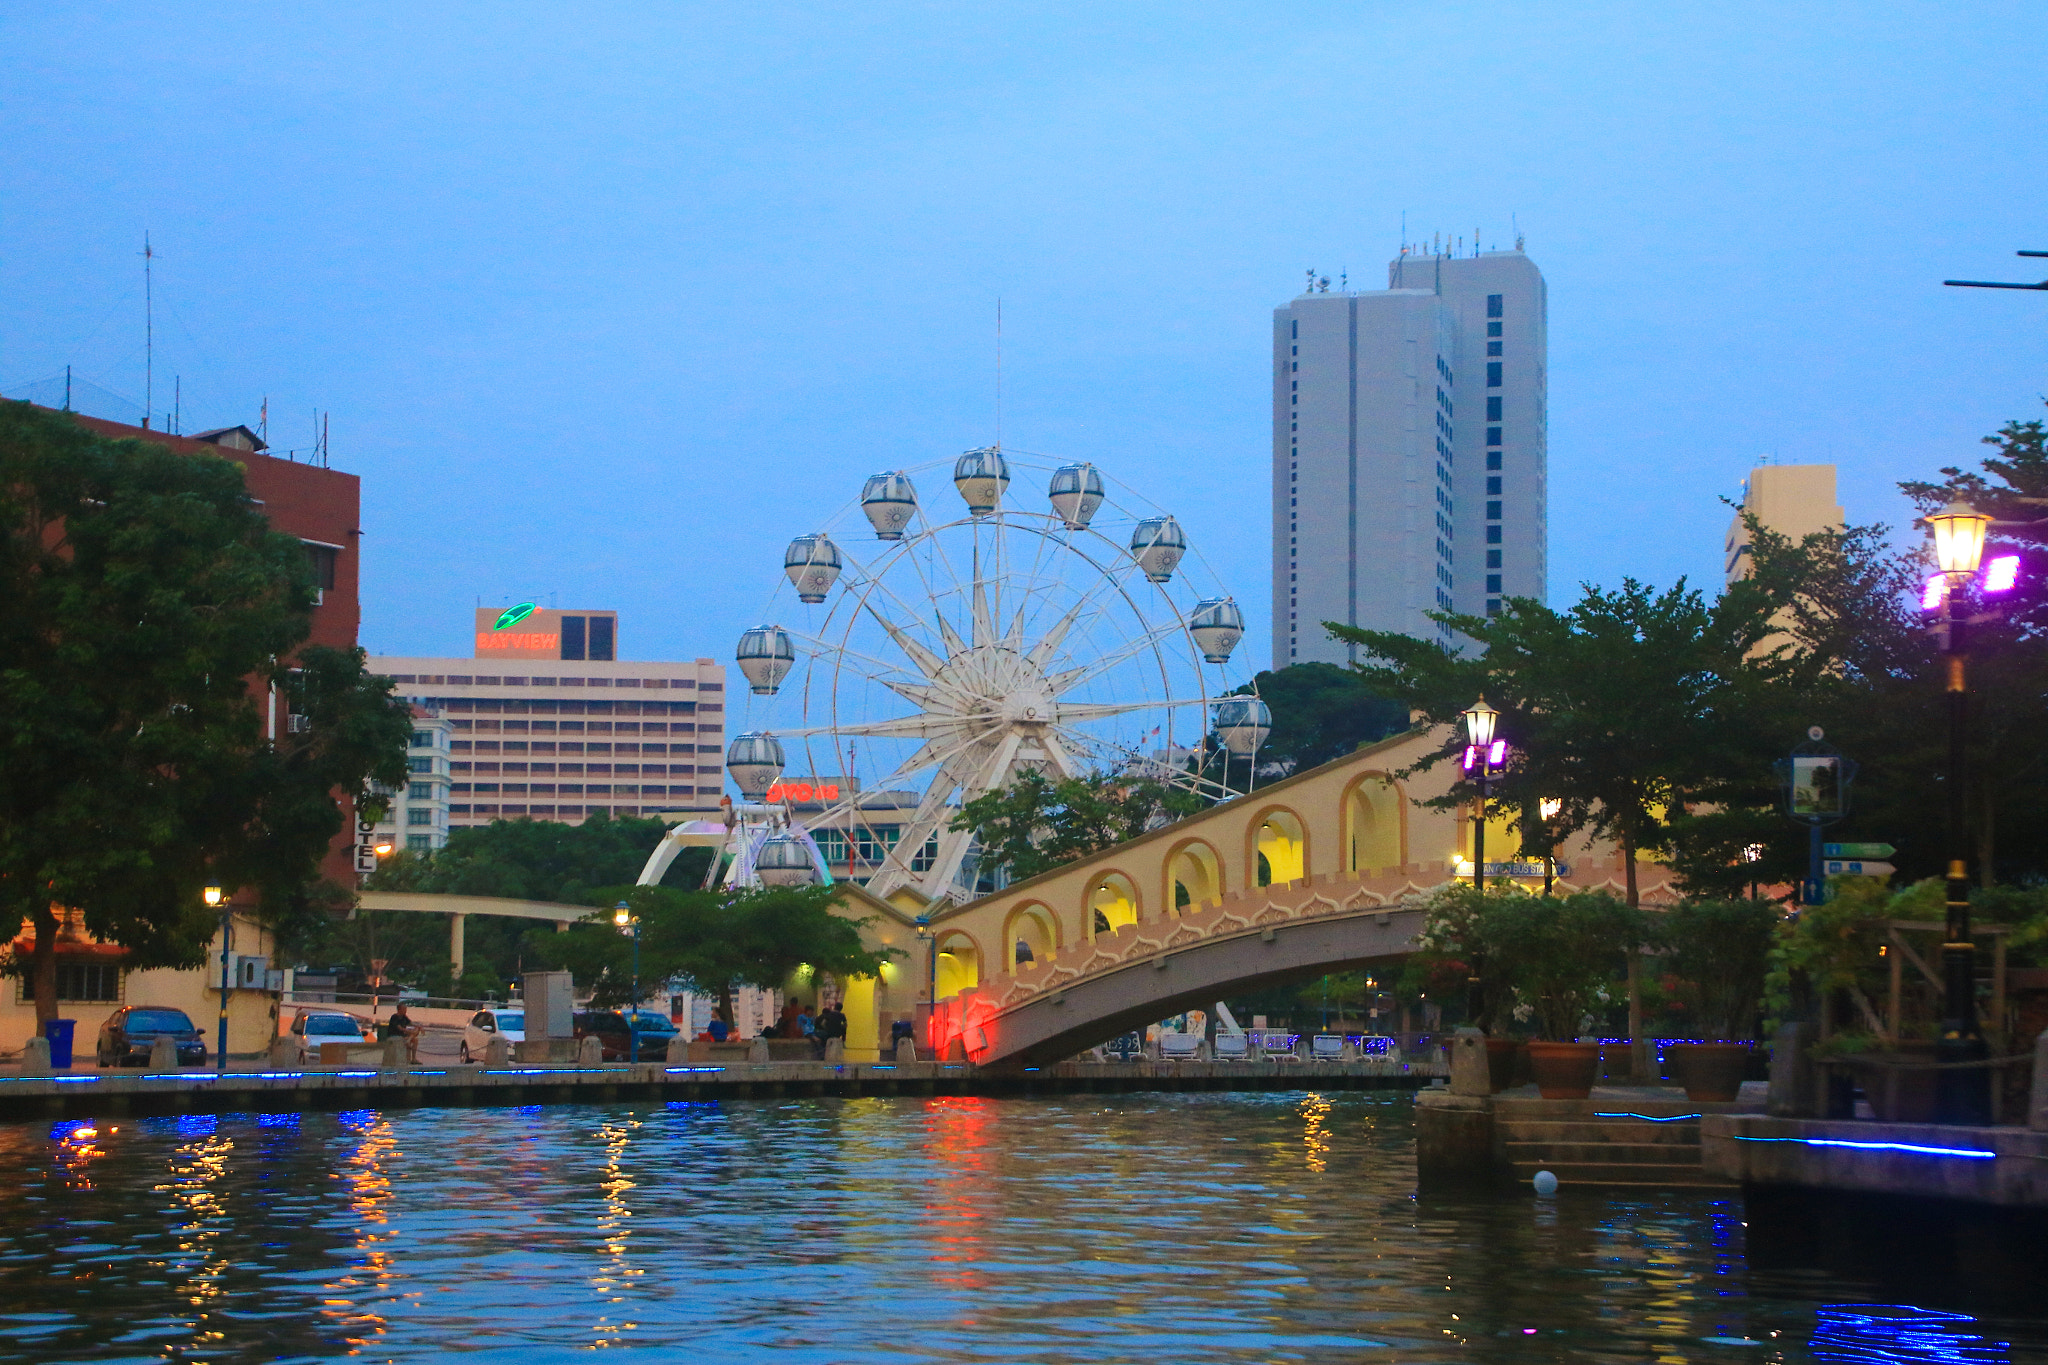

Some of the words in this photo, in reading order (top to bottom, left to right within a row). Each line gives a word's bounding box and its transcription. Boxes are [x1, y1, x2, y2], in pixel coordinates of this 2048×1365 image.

[476, 632, 558, 650] BAYVIEW
[766, 783, 813, 802] OYO
[358, 818, 374, 870] OTEL
[1513, 863, 1529, 874] BUS
